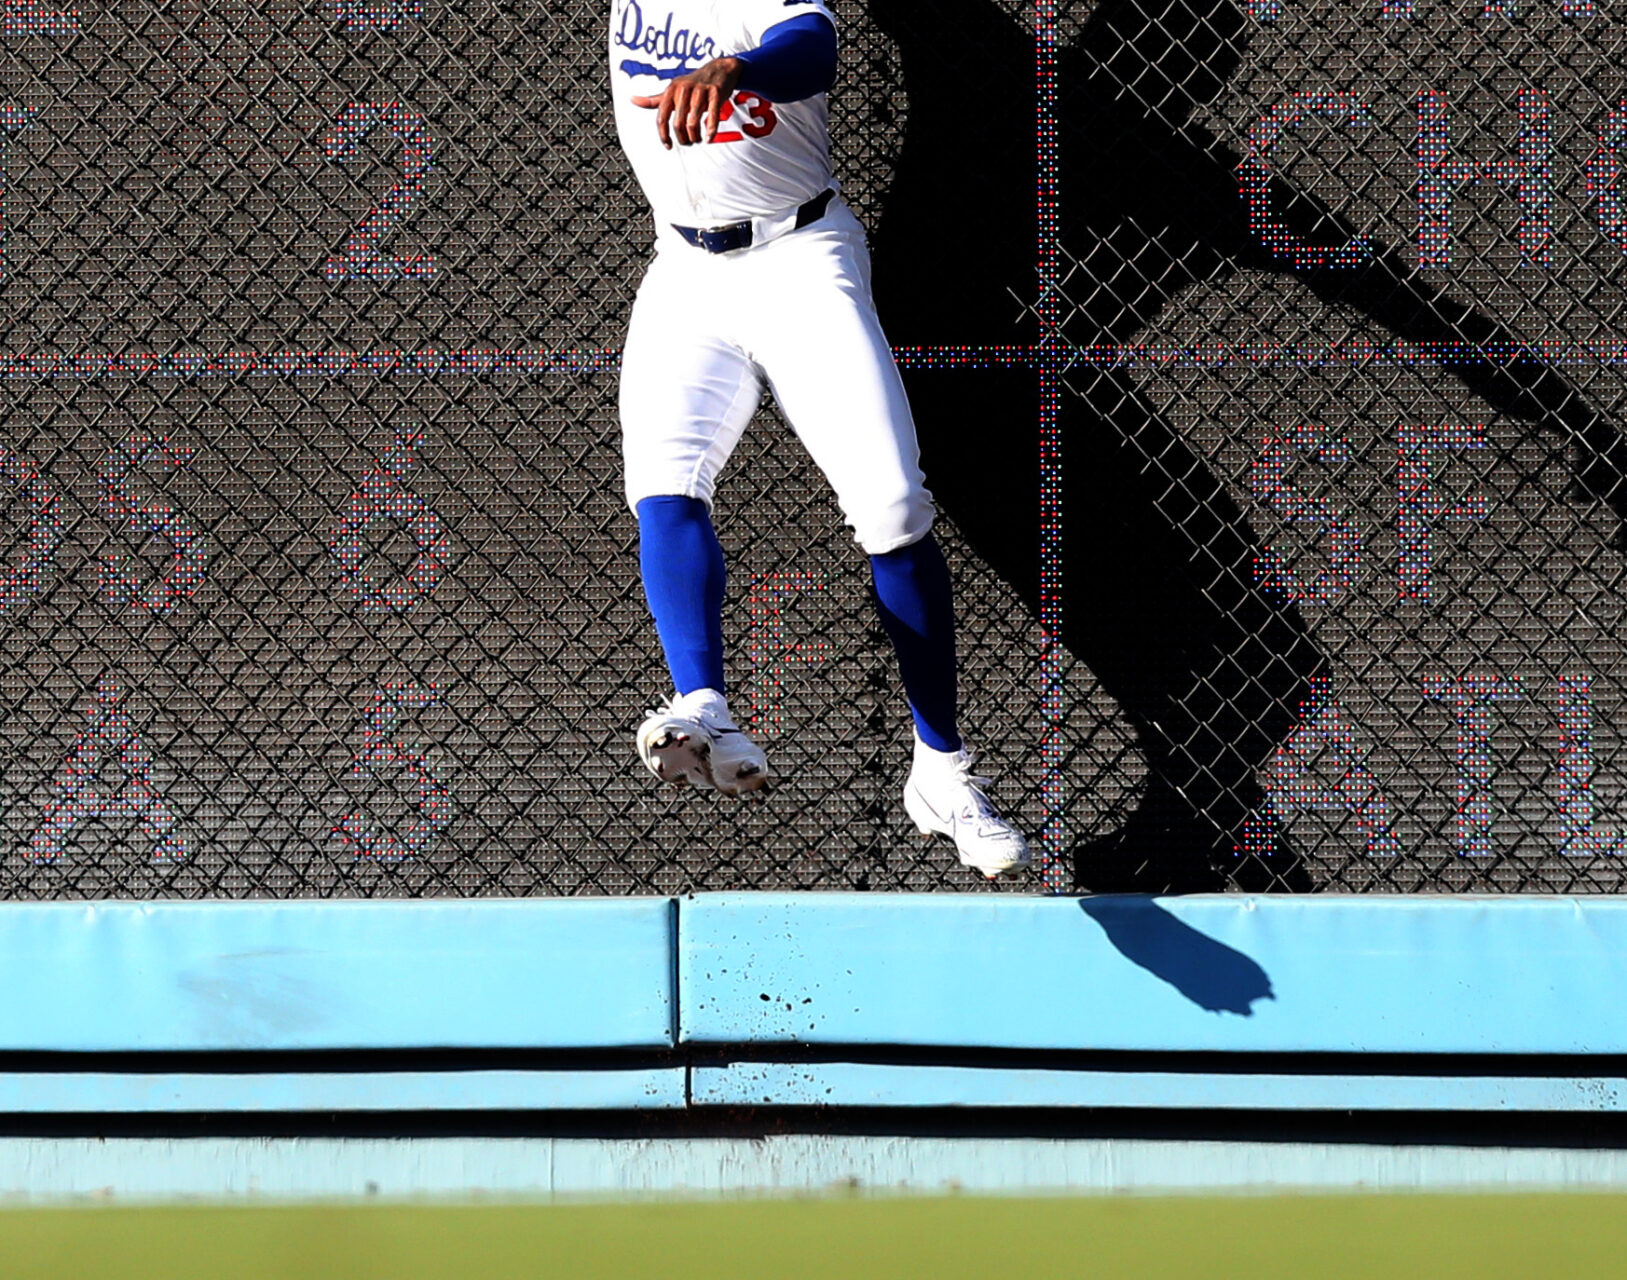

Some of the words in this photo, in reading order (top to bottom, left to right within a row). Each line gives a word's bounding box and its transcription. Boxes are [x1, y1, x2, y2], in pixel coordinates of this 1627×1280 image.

[326, 102, 437, 279] 2
[331, 422, 451, 612] 6
[1252, 424, 1492, 604] SF
[22, 674, 189, 864] A
[332, 682, 453, 862] 5
